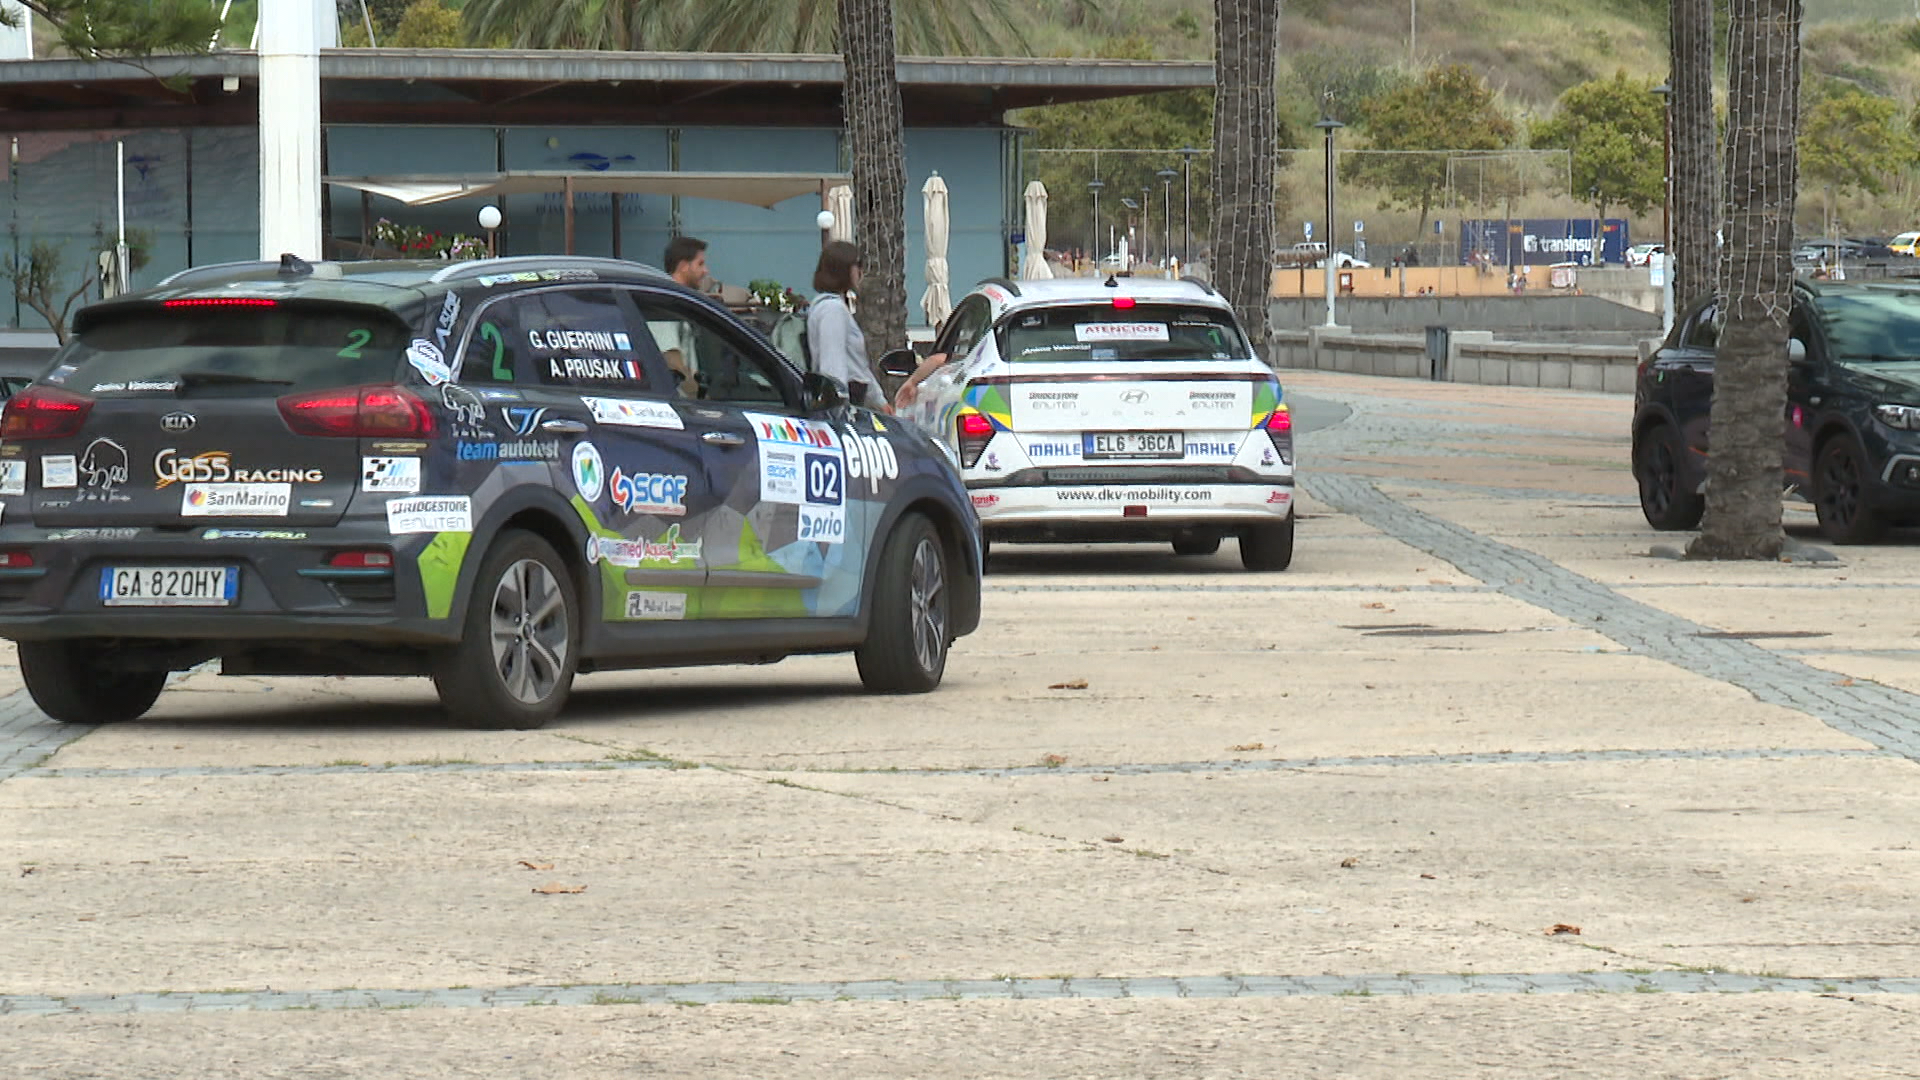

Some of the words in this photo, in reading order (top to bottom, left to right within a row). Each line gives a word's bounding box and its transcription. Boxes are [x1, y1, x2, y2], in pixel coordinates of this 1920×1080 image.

[1539, 235, 1605, 252] transinsur
[339, 328, 373, 358] 2
[529, 330, 548, 350] G.
[547, 332, 615, 351] GUERRINI
[480, 321, 514, 382] 2
[551, 359, 566, 378] A.
[565, 360, 625, 379] PRUSAK
[165, 417, 189, 428] KIA
[1029, 443, 1081, 456] MAHLE
[1185, 442, 1236, 456] MAHLE
[234, 469, 324, 483] RACING
[810, 459, 839, 499] 02
[635, 474, 687, 505] SCAF
[1056, 488, 1212, 503] www.dkv-mobility.com
[391, 500, 468, 514] BRIDGESTONE
[812, 511, 843, 537] prio
[116, 571, 142, 596] GA
[151, 571, 222, 597] 820HY
